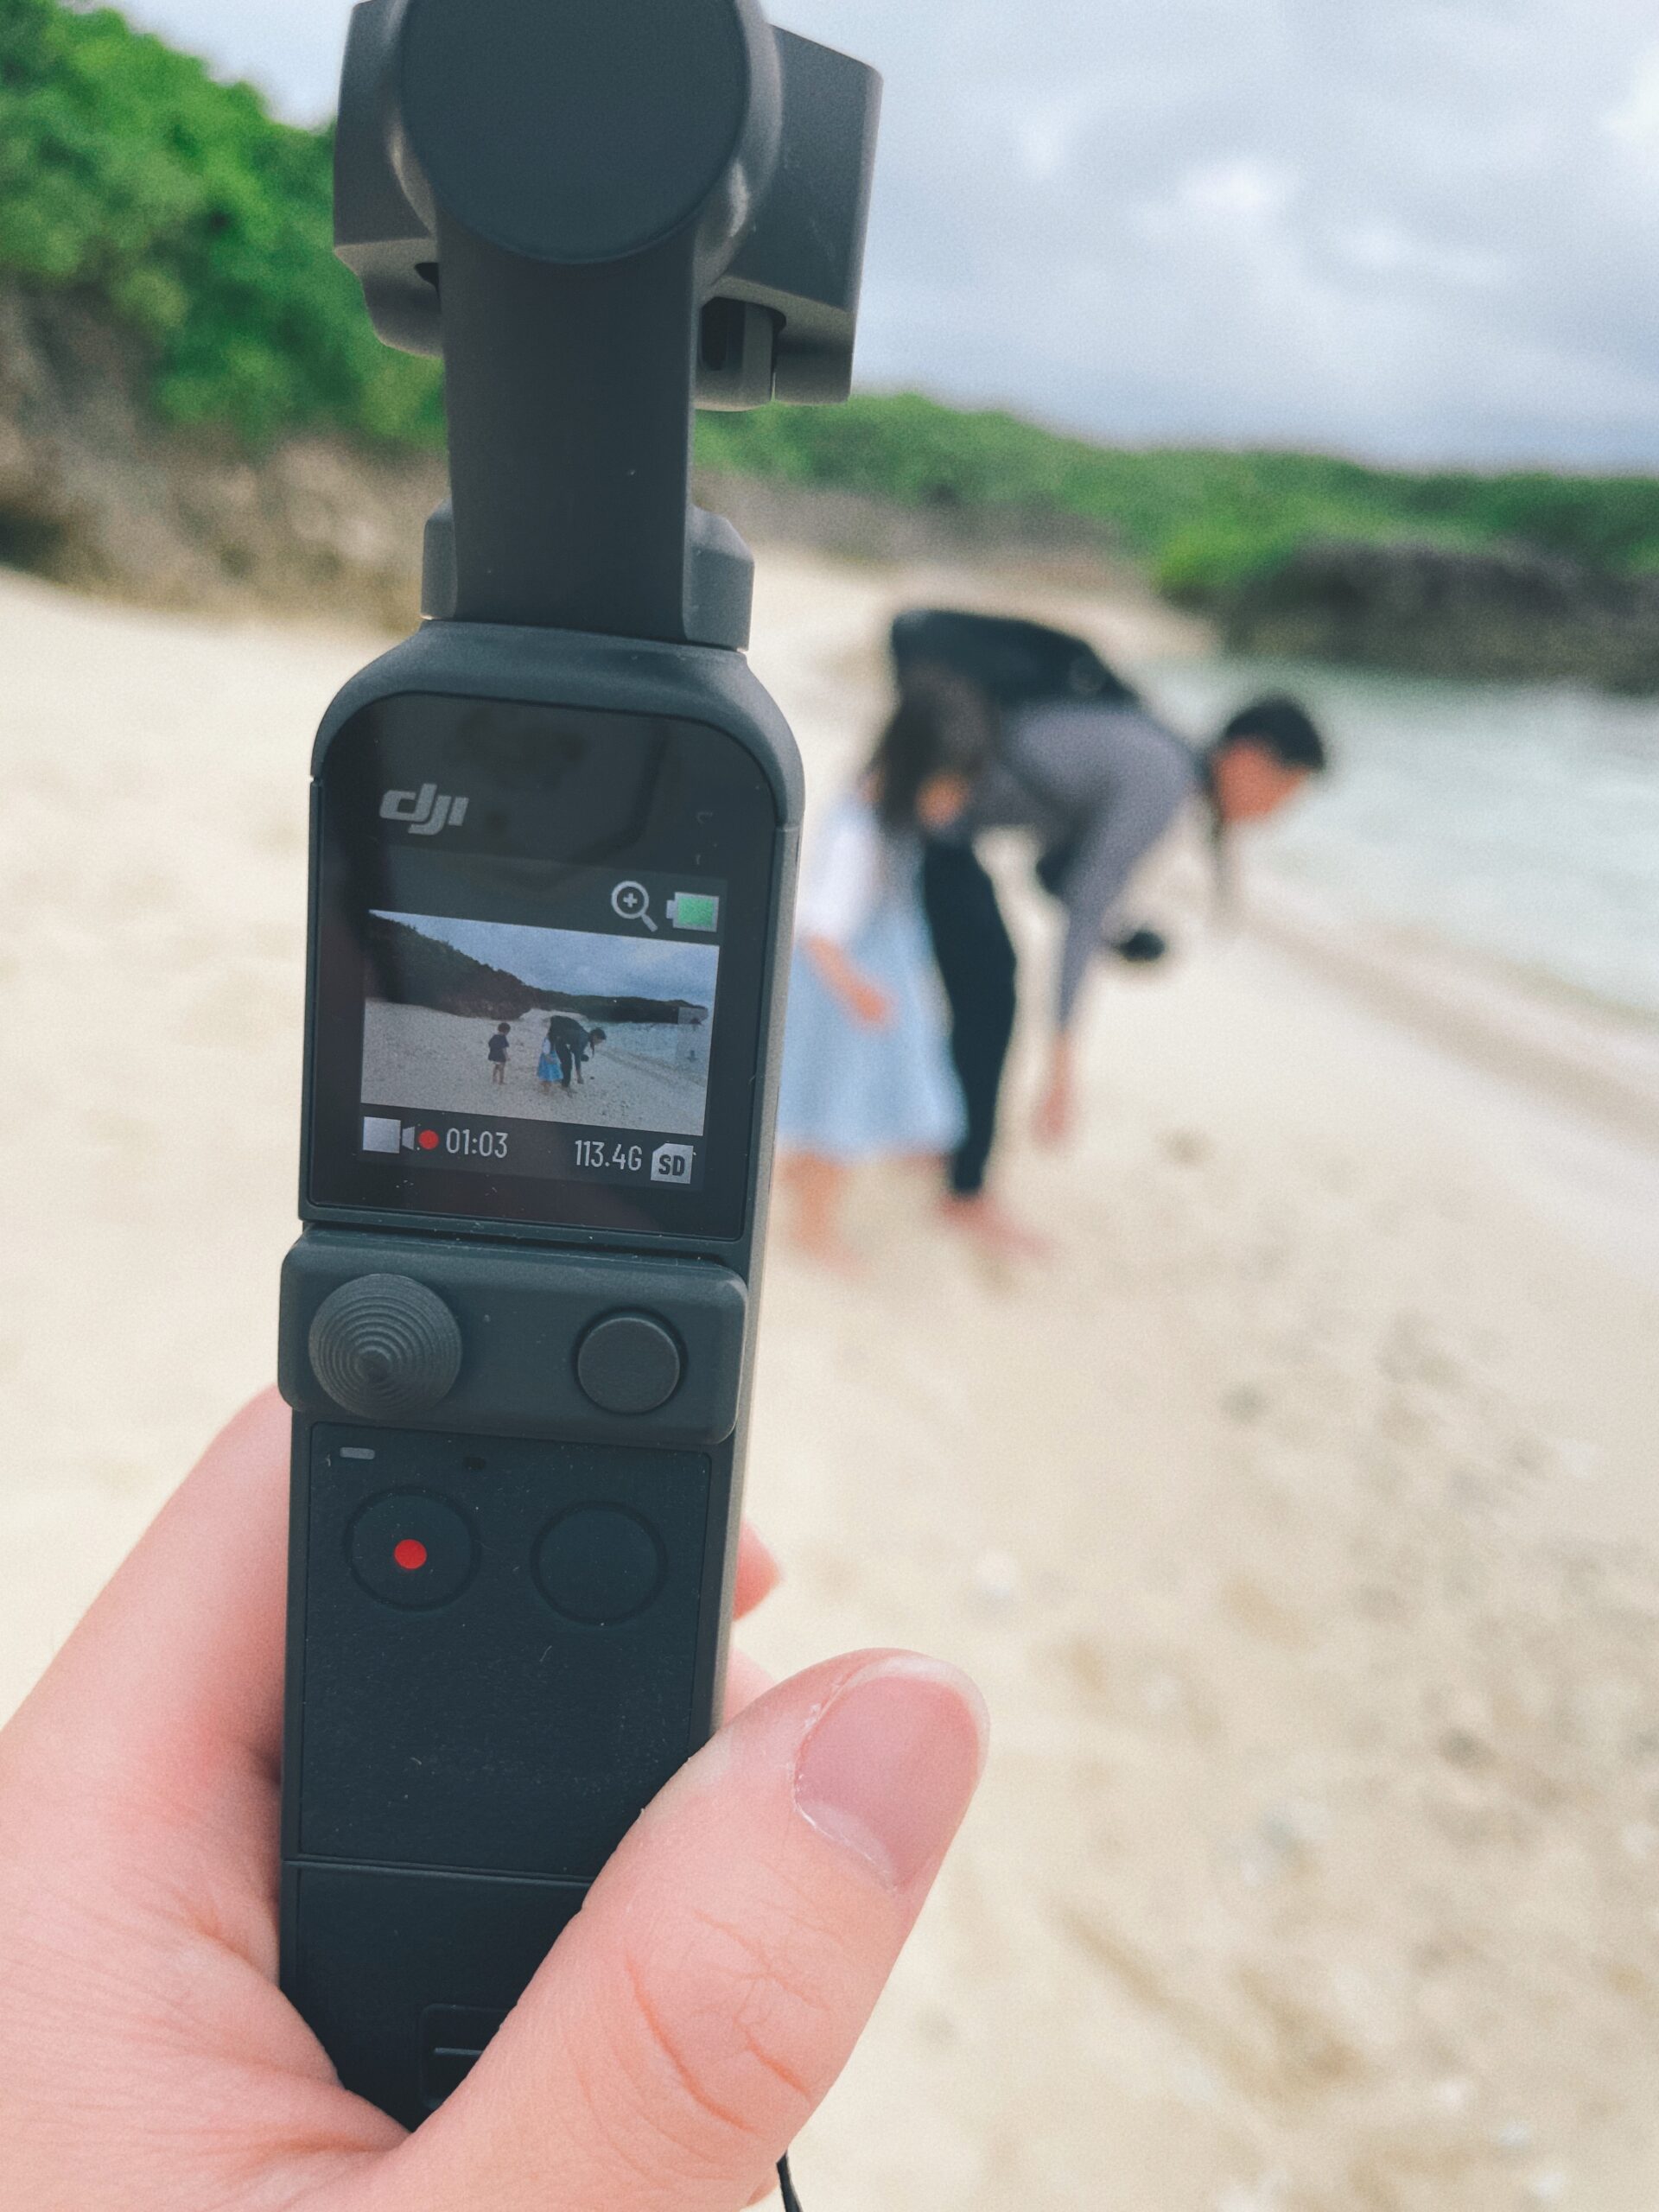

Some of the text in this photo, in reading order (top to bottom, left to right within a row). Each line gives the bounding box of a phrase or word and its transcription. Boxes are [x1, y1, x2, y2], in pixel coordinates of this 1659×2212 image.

[445, 1127, 509, 1159] 01:03
[574, 1138, 643, 1173] 113.4G
[658, 1154, 686, 1178] SD
